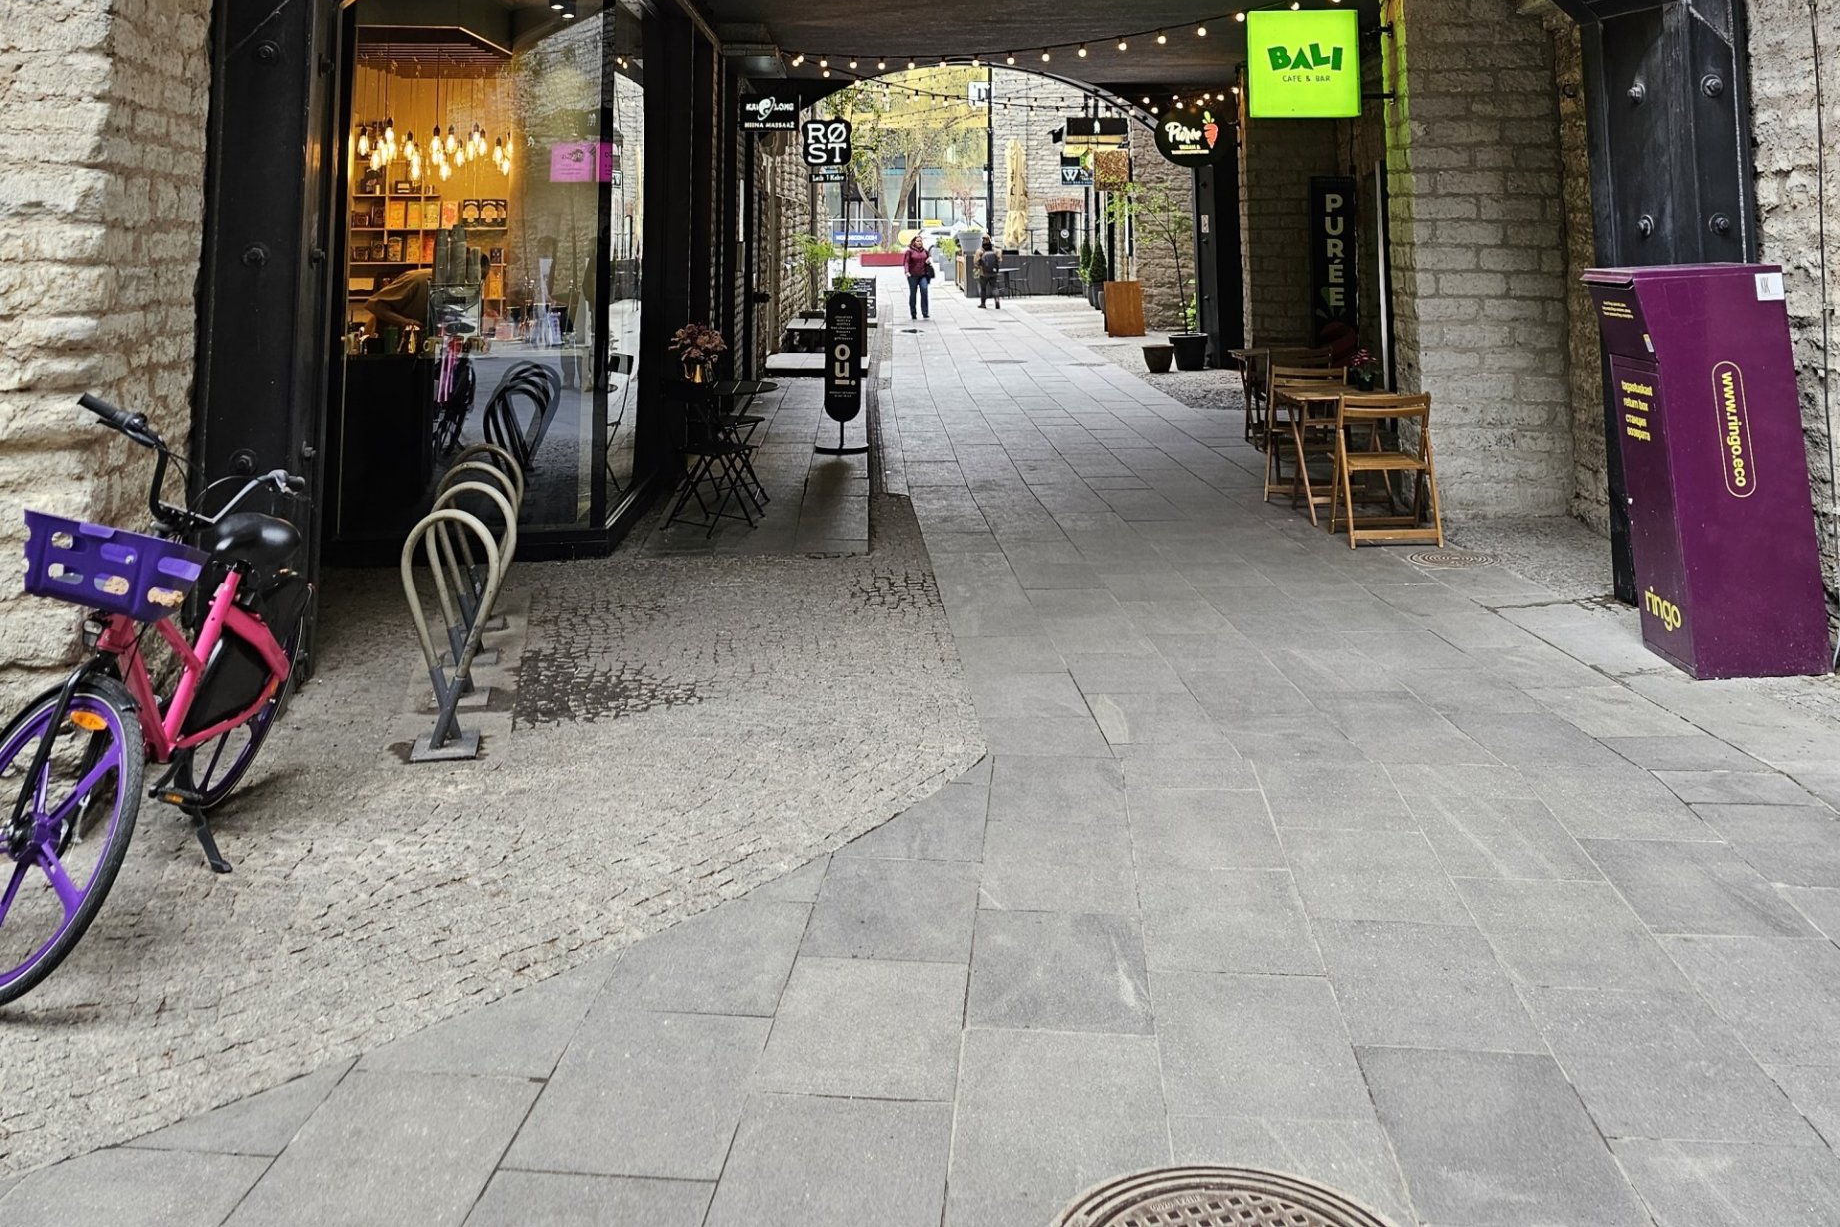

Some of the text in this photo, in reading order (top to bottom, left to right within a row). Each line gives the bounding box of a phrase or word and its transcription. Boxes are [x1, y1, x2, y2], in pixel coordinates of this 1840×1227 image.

[1267, 43, 1343, 71] BALI
[1325, 193, 1345, 306] PURÉE
[1721, 371, 1747, 487] www.ringo.eco
[1644, 585, 1682, 632] ringo
